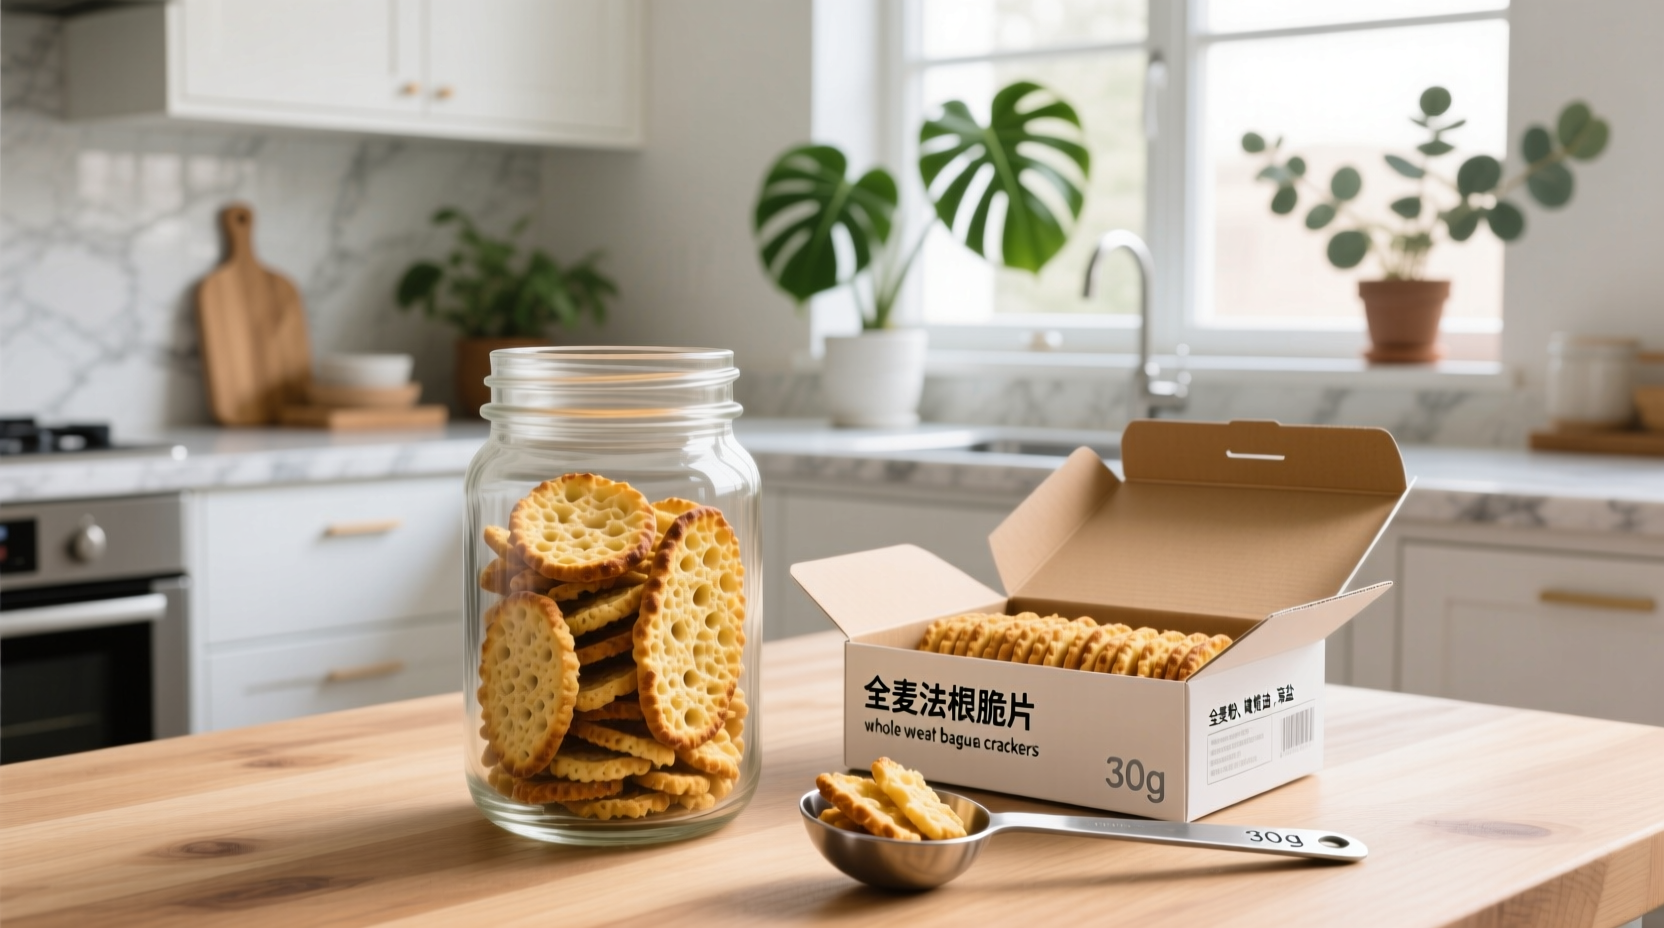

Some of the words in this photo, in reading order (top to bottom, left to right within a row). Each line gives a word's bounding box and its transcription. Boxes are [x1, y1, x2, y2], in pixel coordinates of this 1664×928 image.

[864, 675, 1034, 731] 全麦法根脆片
[865, 718, 901, 736] whole
[904, 726, 937, 742] weat
[984, 737, 1039, 757] crackers
[1105, 756, 1165, 803] 30g
[1245, 830, 1304, 847] 30g
